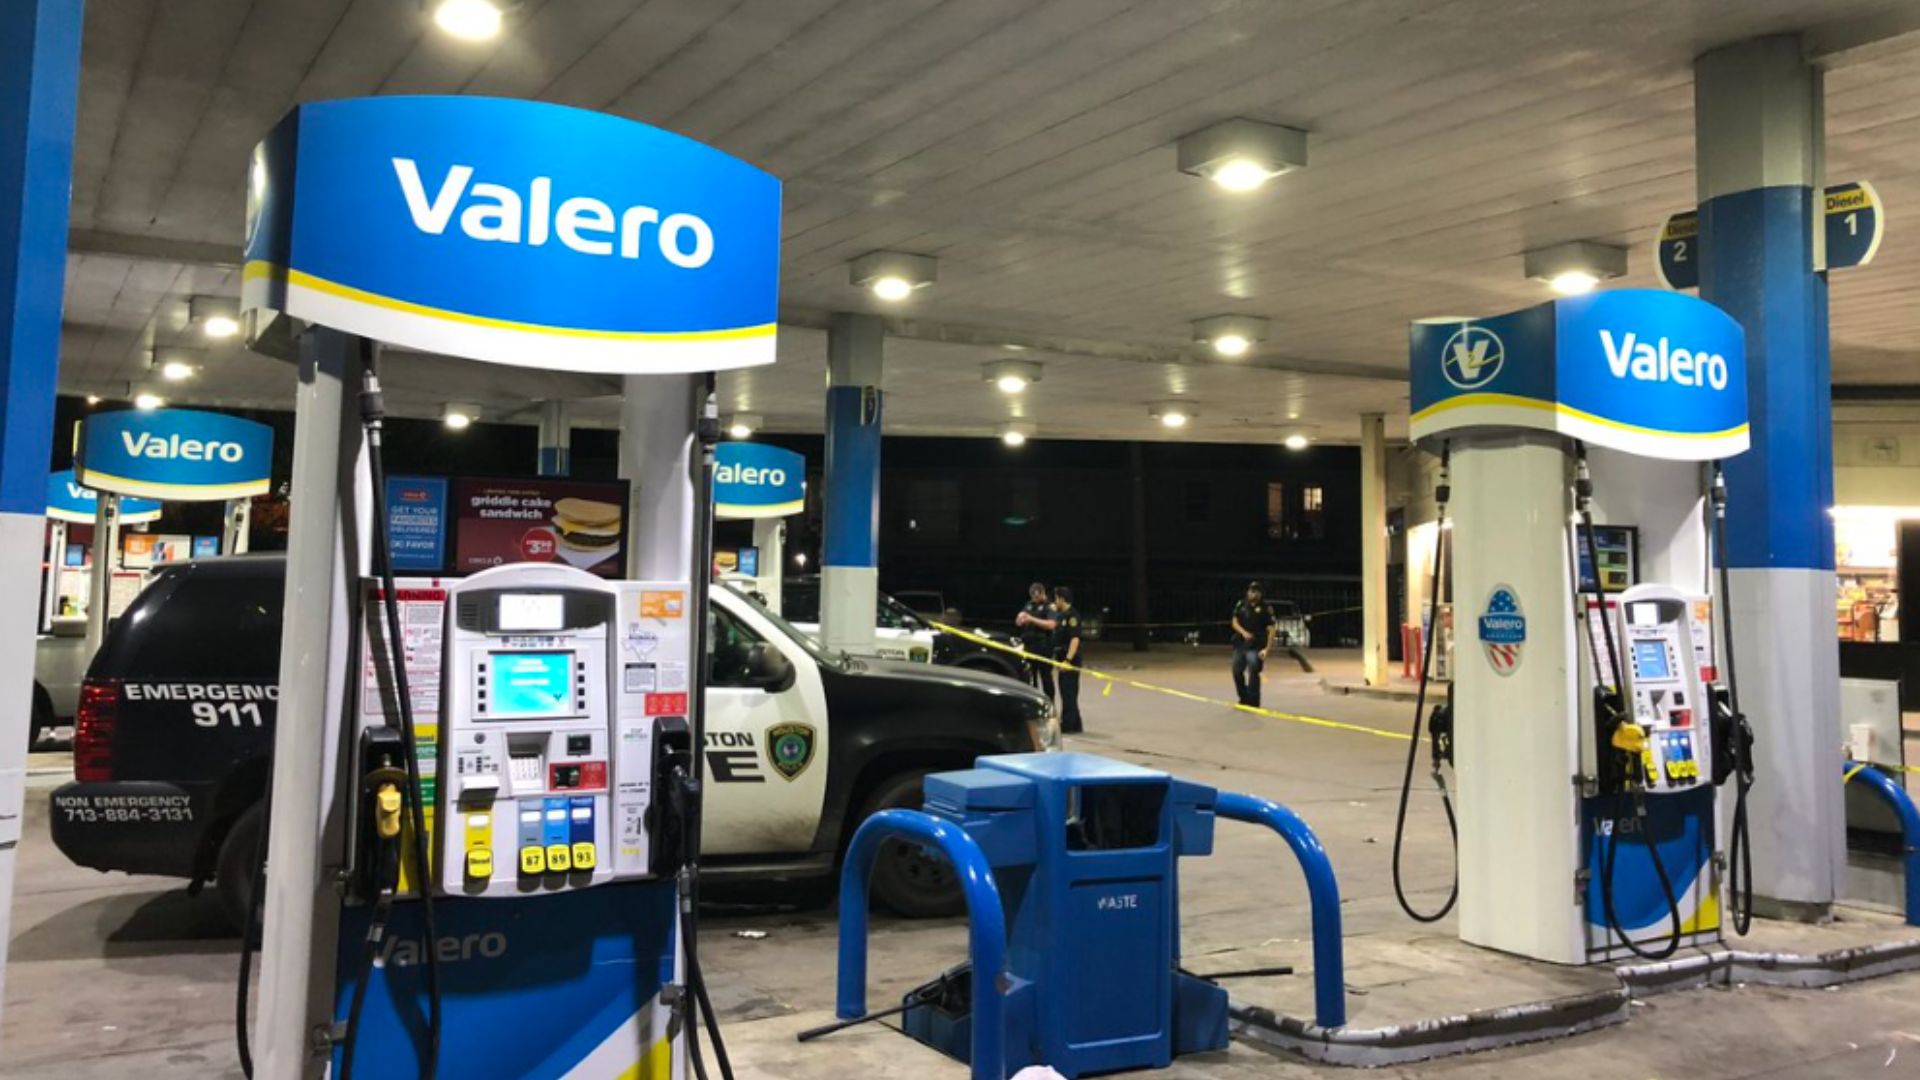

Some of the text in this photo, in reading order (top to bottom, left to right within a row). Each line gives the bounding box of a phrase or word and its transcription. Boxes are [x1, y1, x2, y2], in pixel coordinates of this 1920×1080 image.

[1826, 191, 1864, 210] Diesel
[392, 157, 714, 268] Valero
[1844, 213, 1857, 236] 1
[1673, 240, 1687, 262] 2
[1600, 329, 1728, 391] Valero
[121, 430, 243, 463] Valero
[471, 495, 552, 507] griddle cake
[480, 507, 542, 519] sandwich
[1484, 617, 1523, 630] Valero
[124, 683, 279, 700] EMERGENC
[192, 702, 262, 727] 911
[56, 795, 191, 807] NON EMERGENCY
[64, 808, 193, 822] 713-884-3131
[525, 855, 540, 866] 87
[551, 854, 566, 864] 89
[576, 852, 591, 862] 93
[1098, 894, 1137, 910] WASTE
